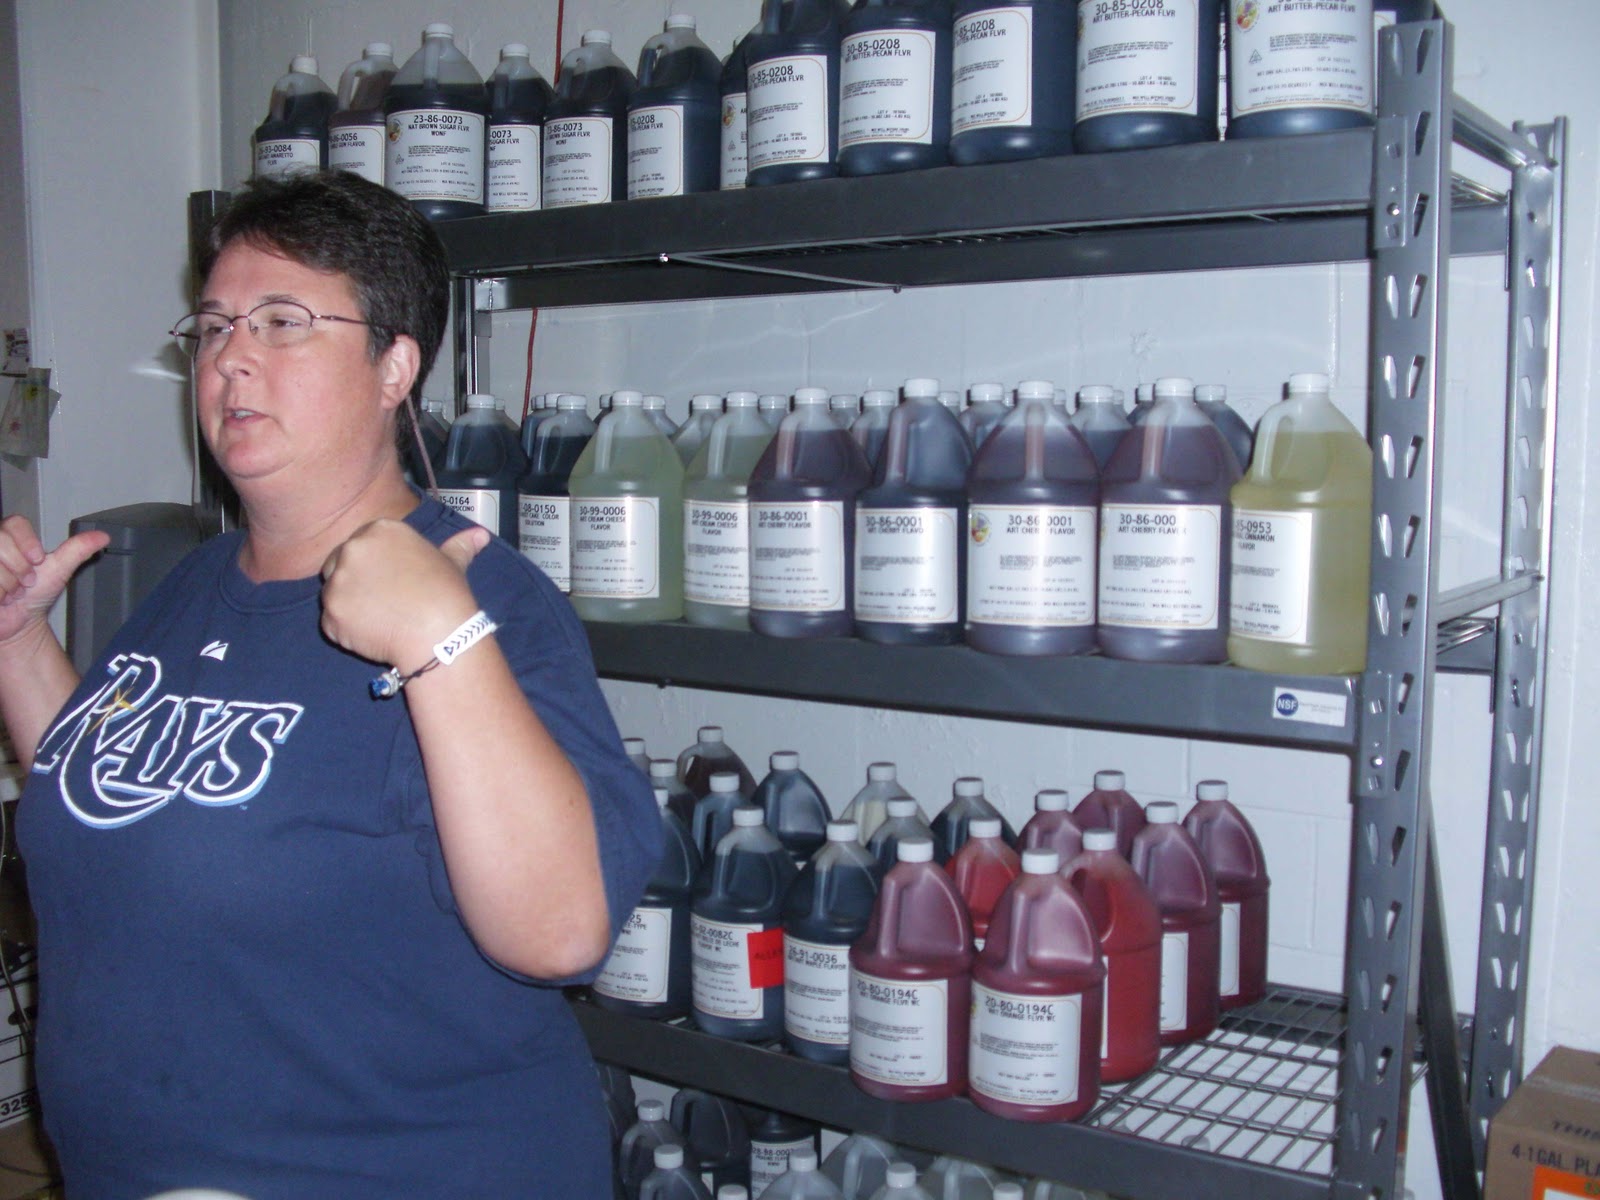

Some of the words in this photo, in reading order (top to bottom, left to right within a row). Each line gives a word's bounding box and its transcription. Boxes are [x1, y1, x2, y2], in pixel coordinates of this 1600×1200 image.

[1268, 6, 1281, 14] ART
[1284, 2, 1338, 11] BUTTER-PECAN
[1104, 9, 1155, 20] BUTTER-PECAN
[990, 29, 1006, 37] FLVR
[847, 38, 900, 55] 30-85-0208
[894, 49, 911, 57] FLVR
[788, 74, 804, 82] FLVR
[413, 115, 463, 124] 23-86-0073
[580, 506, 626, 515] 30-99-0006
[1131, 526, 1156, 534] CHERRY
[1278, 699, 1297, 710] NSF
